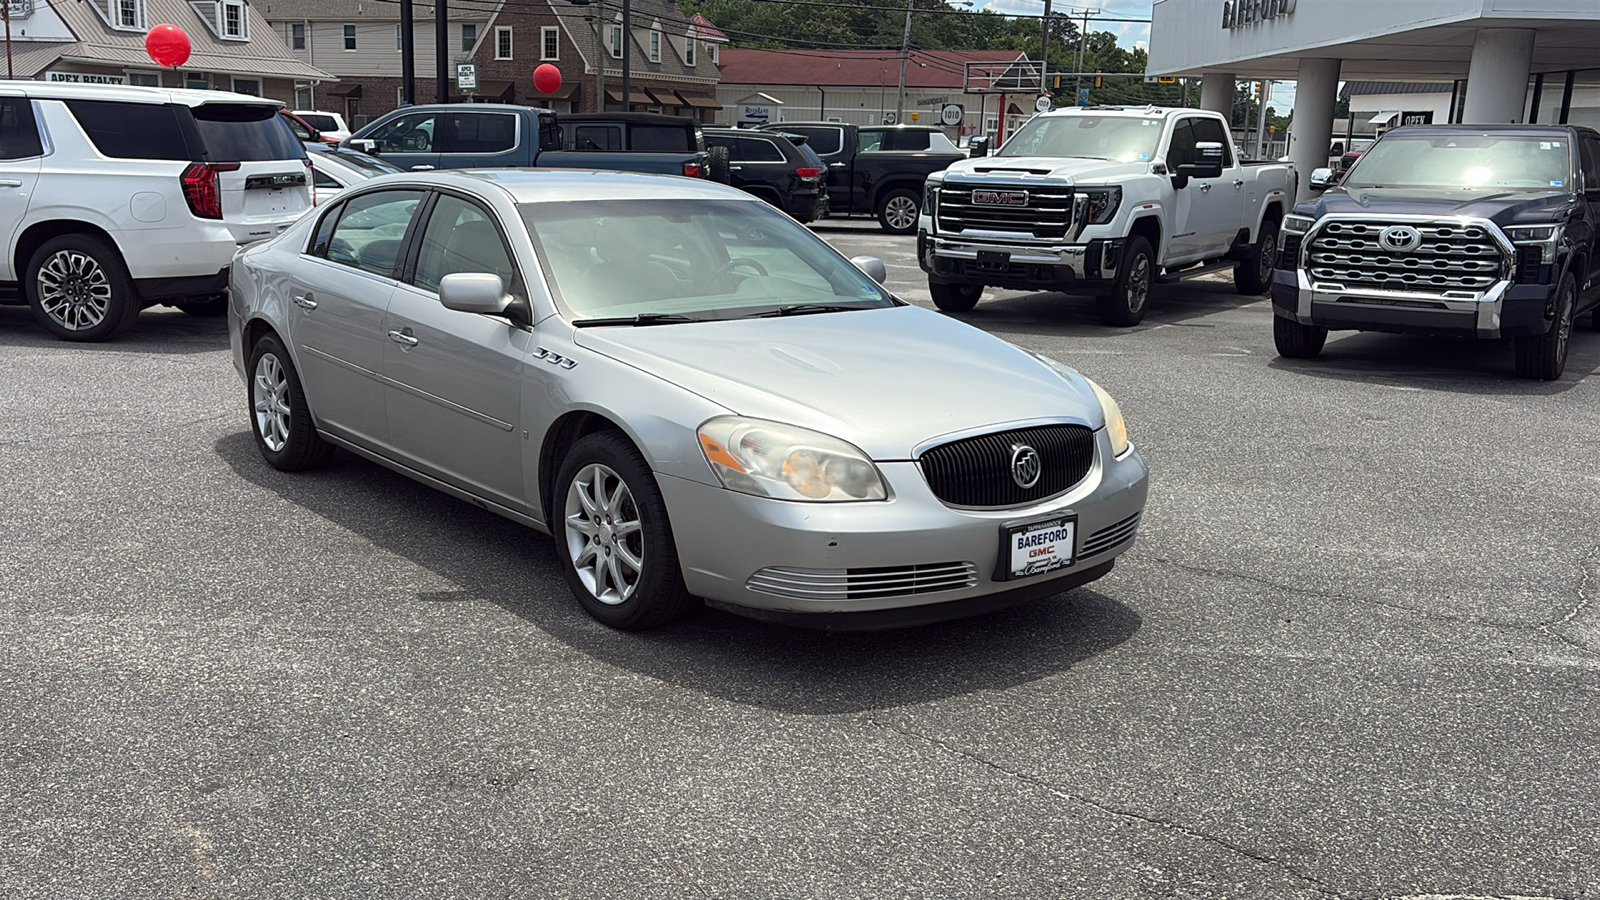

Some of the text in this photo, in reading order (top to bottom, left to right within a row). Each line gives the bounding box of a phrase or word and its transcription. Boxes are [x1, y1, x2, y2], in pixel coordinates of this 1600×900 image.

[51, 73, 123, 85] APEX REALTY
[944, 110, 960, 119] 1010
[1405, 115, 1426, 126] OPEN
[976, 191, 1024, 204] GMC
[1017, 528, 1068, 550] BAREFORD
[1029, 545, 1056, 558] GMC
